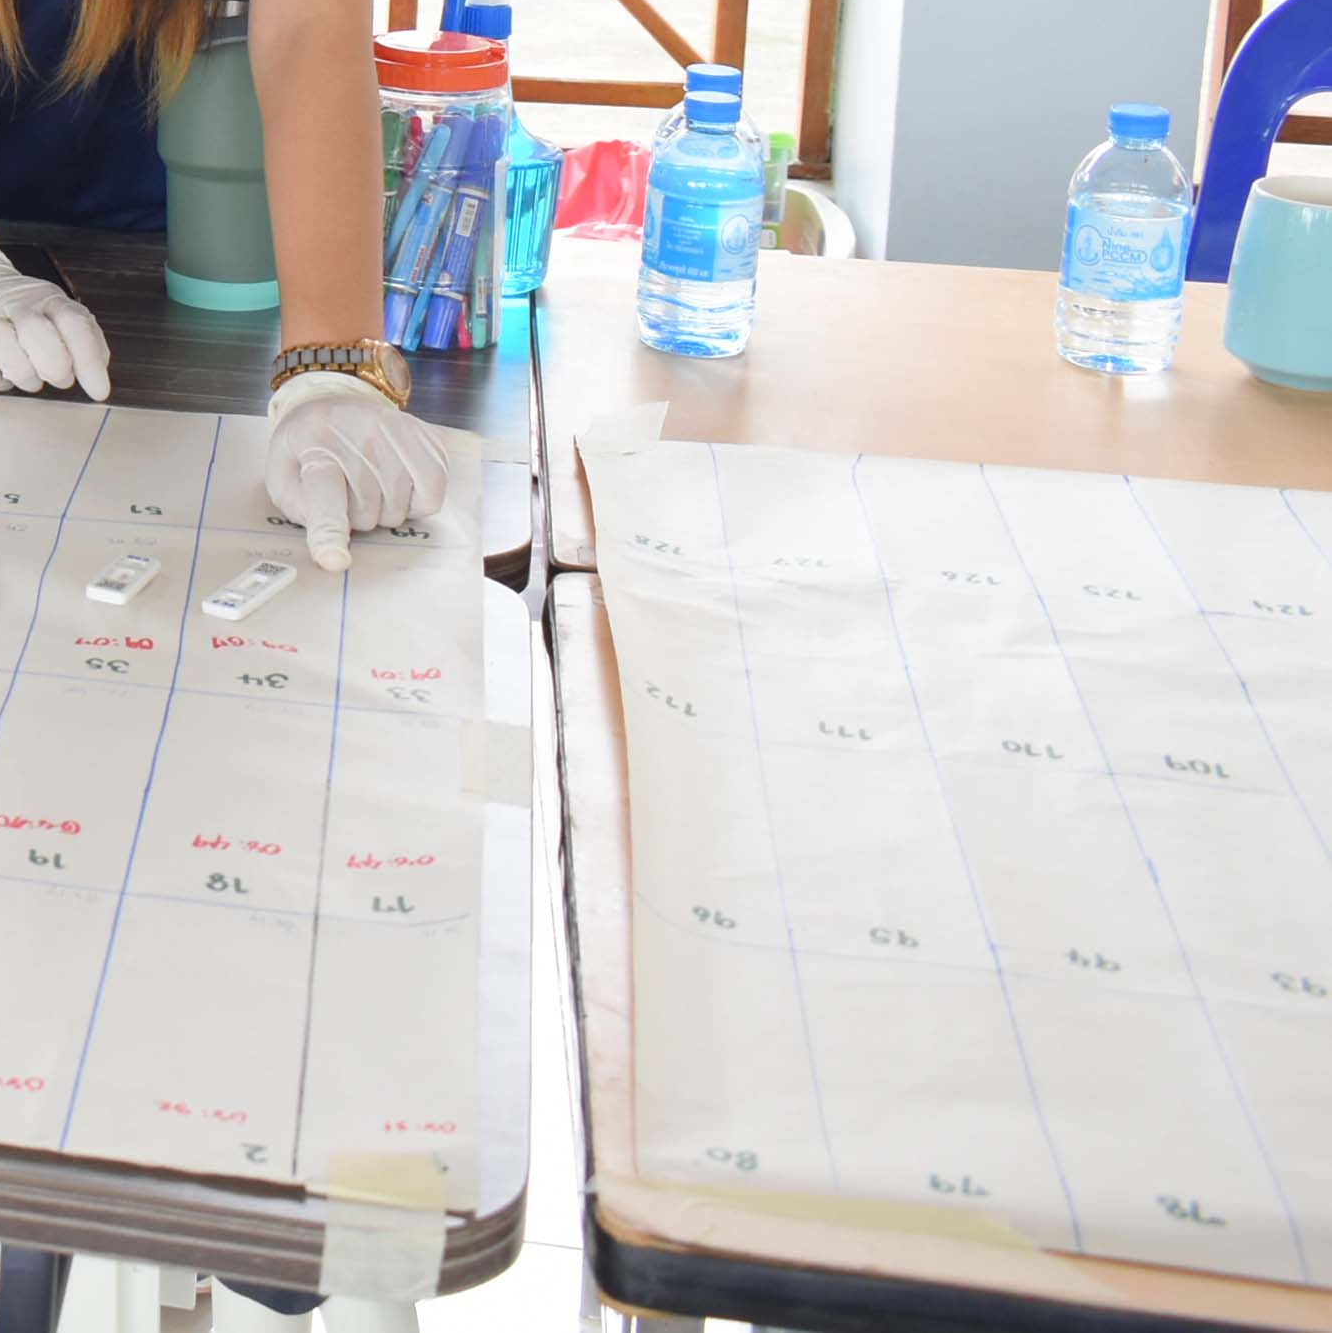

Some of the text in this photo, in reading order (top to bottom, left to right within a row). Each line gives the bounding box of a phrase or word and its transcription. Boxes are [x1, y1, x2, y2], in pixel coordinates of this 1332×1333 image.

[129, 504, 163, 516] 51
[940, 570, 1002, 586] 126
[1081, 584, 1142, 602] 125
[1252, 599, 1314, 617] 124
[84, 657, 130, 674] 35
[237, 672, 290, 690] 34
[384, 685, 432, 704] 33
[646, 681, 698, 718] 112
[818, 720, 872, 742] 111
[1000, 739, 1064, 760] 110
[1163, 754, 1231, 780] 109
[28, 848, 65, 870] 19
[205, 872, 250, 895] 18
[372, 895, 415, 914] 17
[691, 905, 738, 930] 96
[868, 927, 920, 949] 95
[1064, 948, 1122, 972] 94
[1270, 971, 1328, 999] 93
[239, 1142, 269, 1164] 2
[705, 1148, 760, 1175] 80
[928, 1173, 990, 1198] 79
[1156, 1195, 1228, 1229] 78
